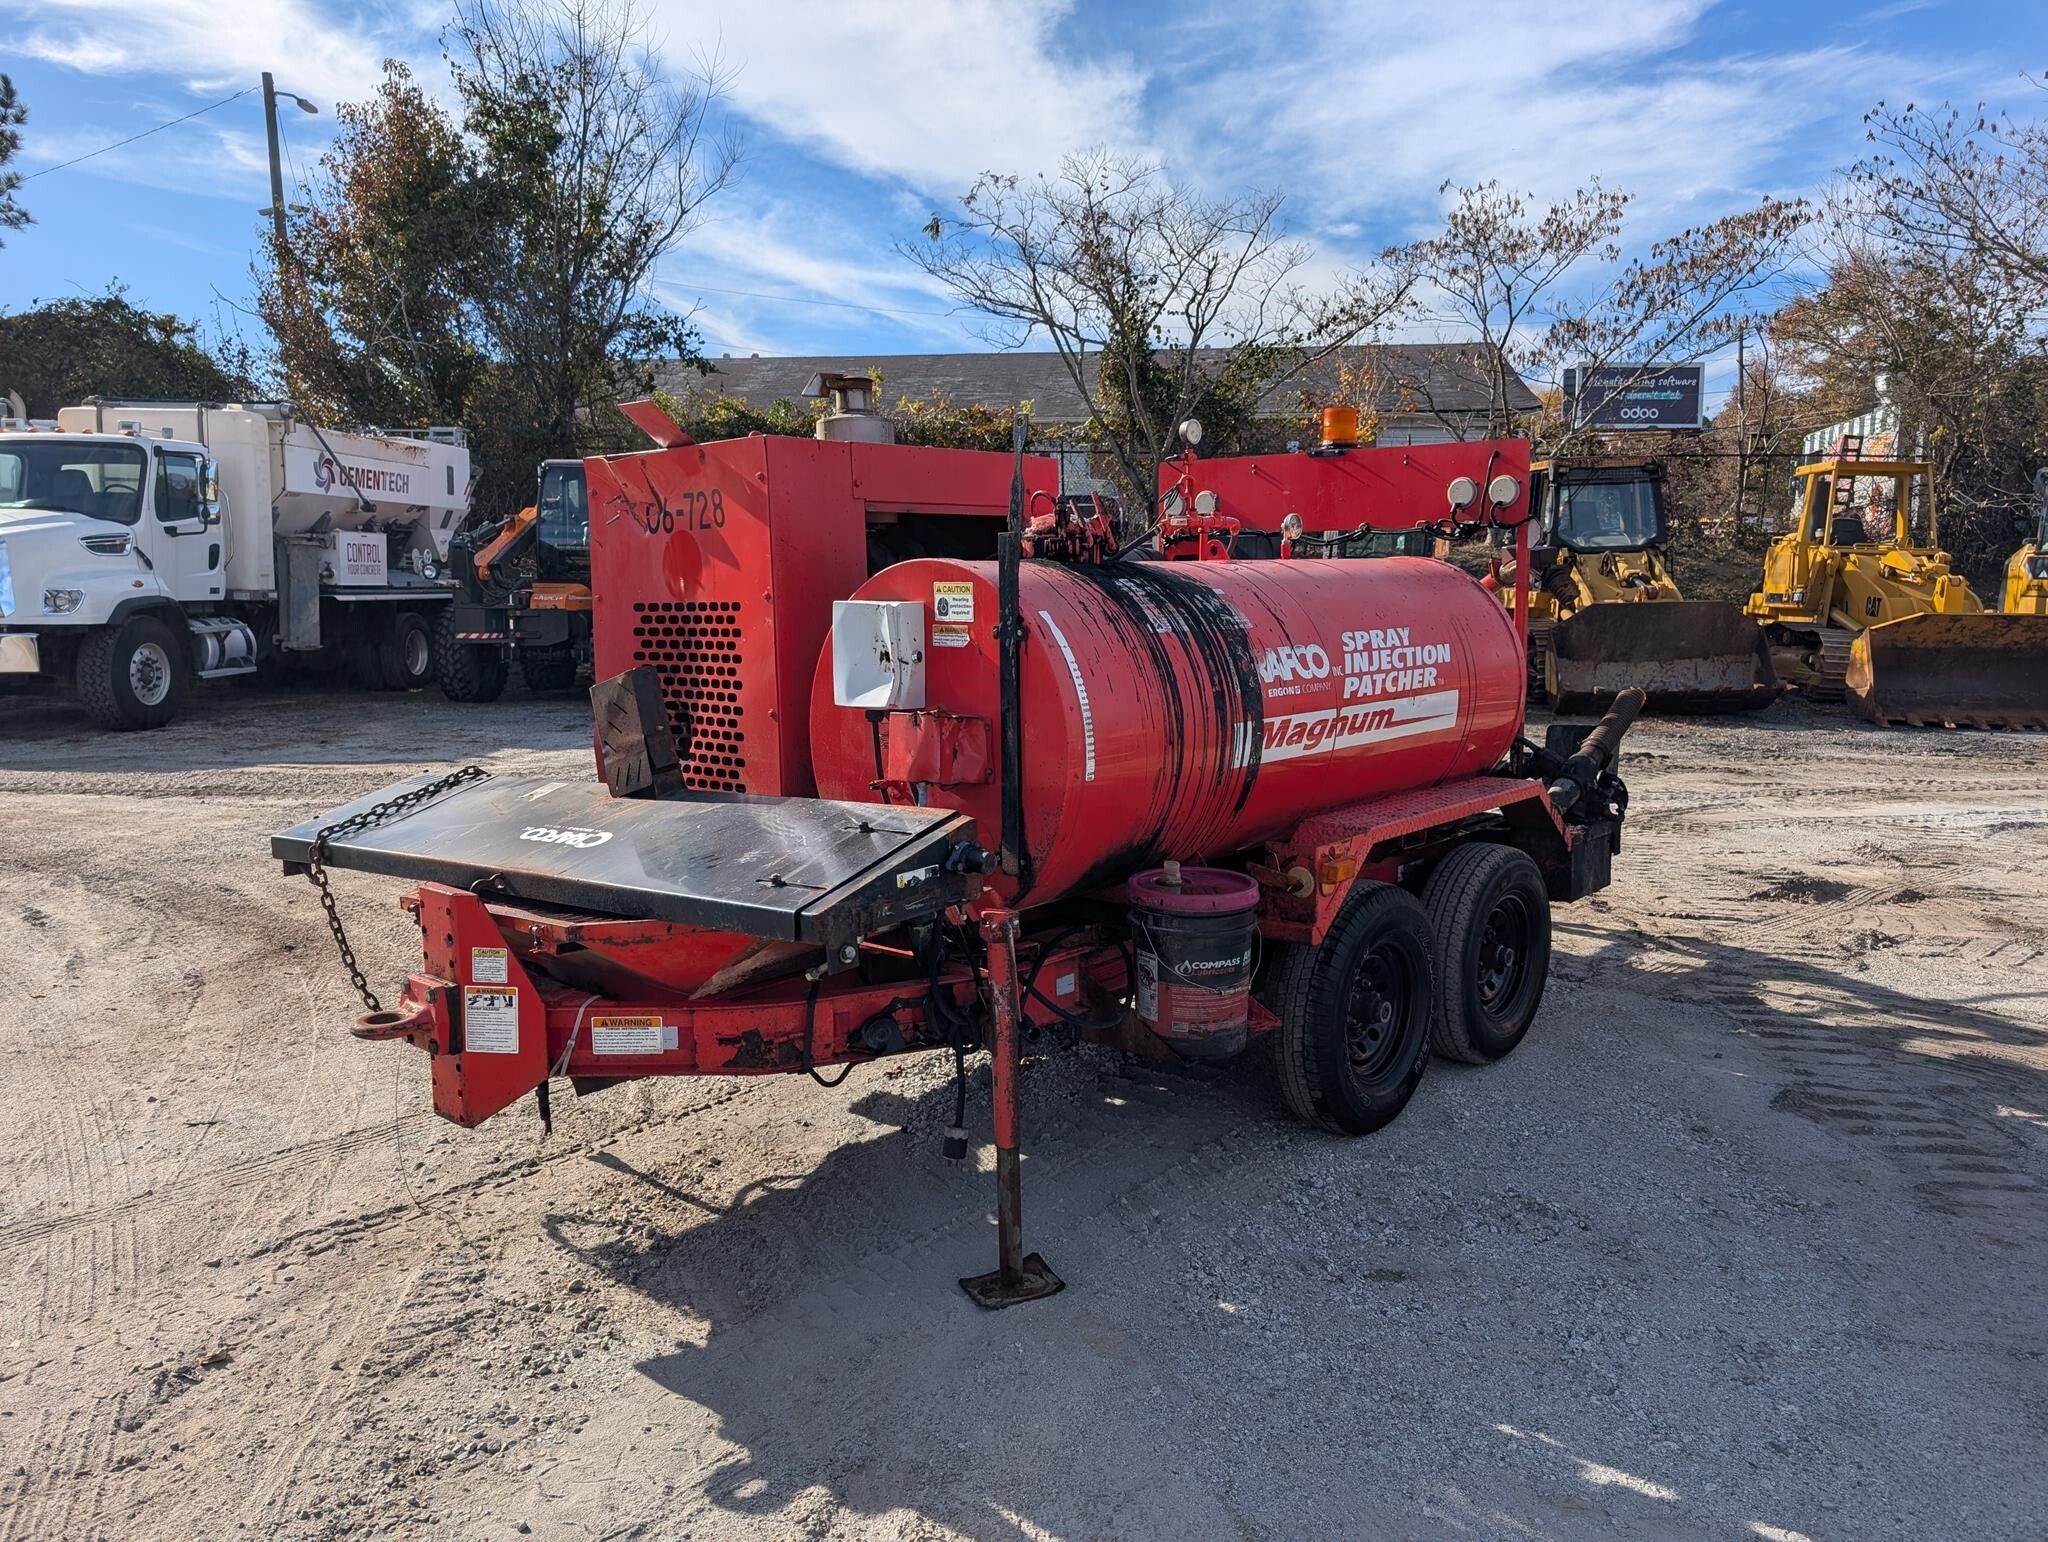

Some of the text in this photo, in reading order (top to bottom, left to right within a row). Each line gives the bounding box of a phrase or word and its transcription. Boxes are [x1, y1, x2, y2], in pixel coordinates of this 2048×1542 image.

[1658, 376, 1697, 387] software
[1621, 406, 1659, 419] odoo
[340, 466, 409, 494] CEMENTECH
[646, 488, 725, 535] 06-728
[347, 543, 381, 563] CONTROL
[347, 564, 381, 576] YOUR CONCRETE
[942, 585, 971, 593] CAUTION
[1865, 596, 1882, 617] CAT
[1341, 627, 1410, 651] SPRAY
[1344, 643, 1450, 674] INJECTION
[1268, 681, 1332, 697] ERGON COMPANY
[1343, 667, 1437, 699] PATCHER
[1263, 707, 1394, 750] Magnum
[1191, 957, 1240, 969] COMPASS
[609, 1019, 652, 1027] WARNING
